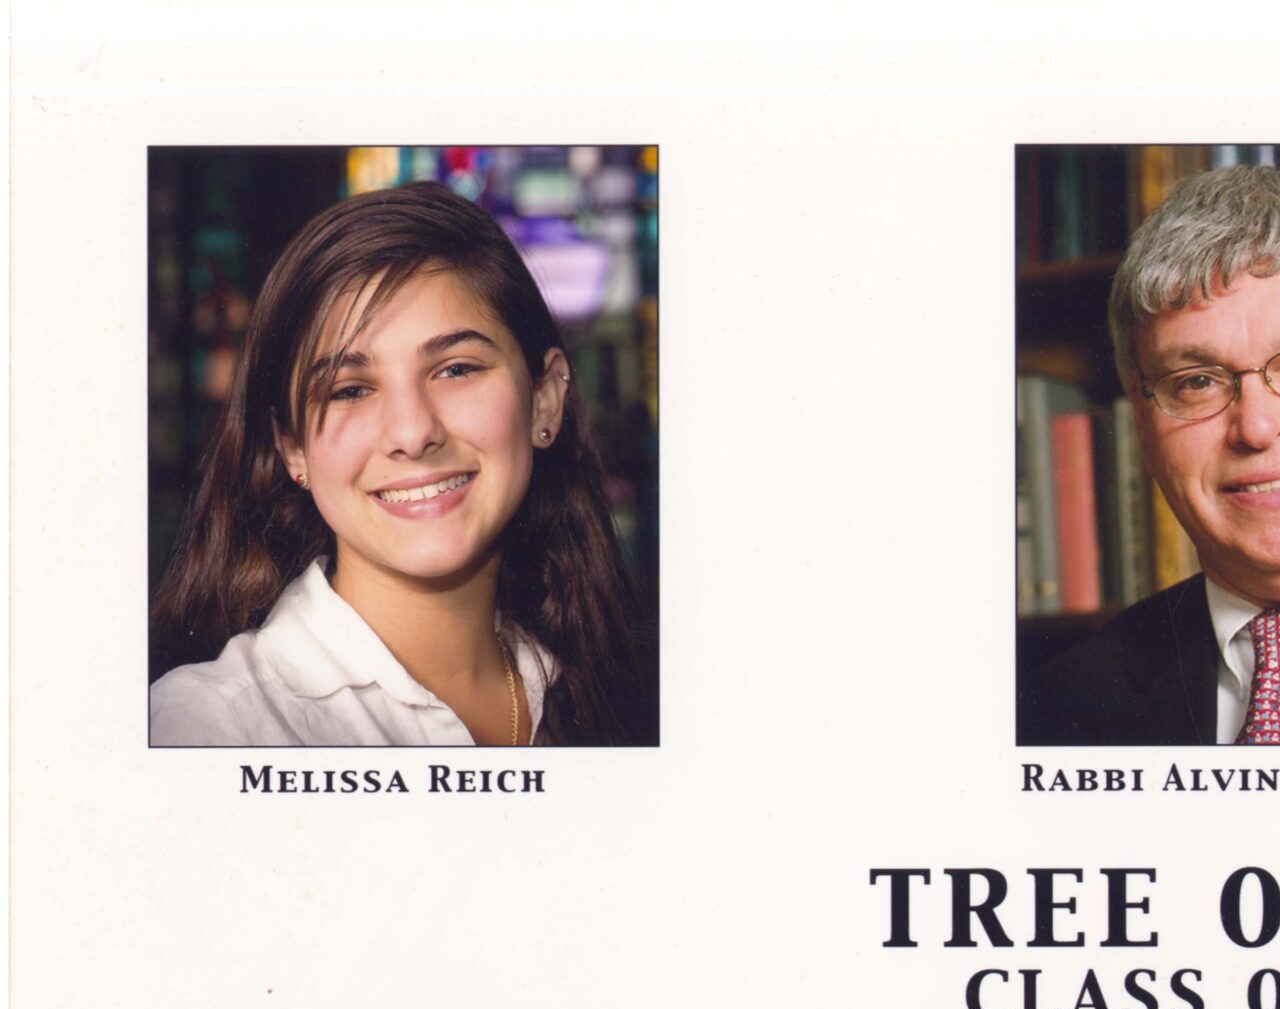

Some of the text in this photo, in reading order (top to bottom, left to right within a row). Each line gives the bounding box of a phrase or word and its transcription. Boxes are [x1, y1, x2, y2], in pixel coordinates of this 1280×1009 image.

[239, 764, 545, 794] MELISSA REICH
[1021, 763, 1144, 792] RABBI
[1162, 763, 1280, 792] ALVIN
[869, 867, 1159, 948] TREE
